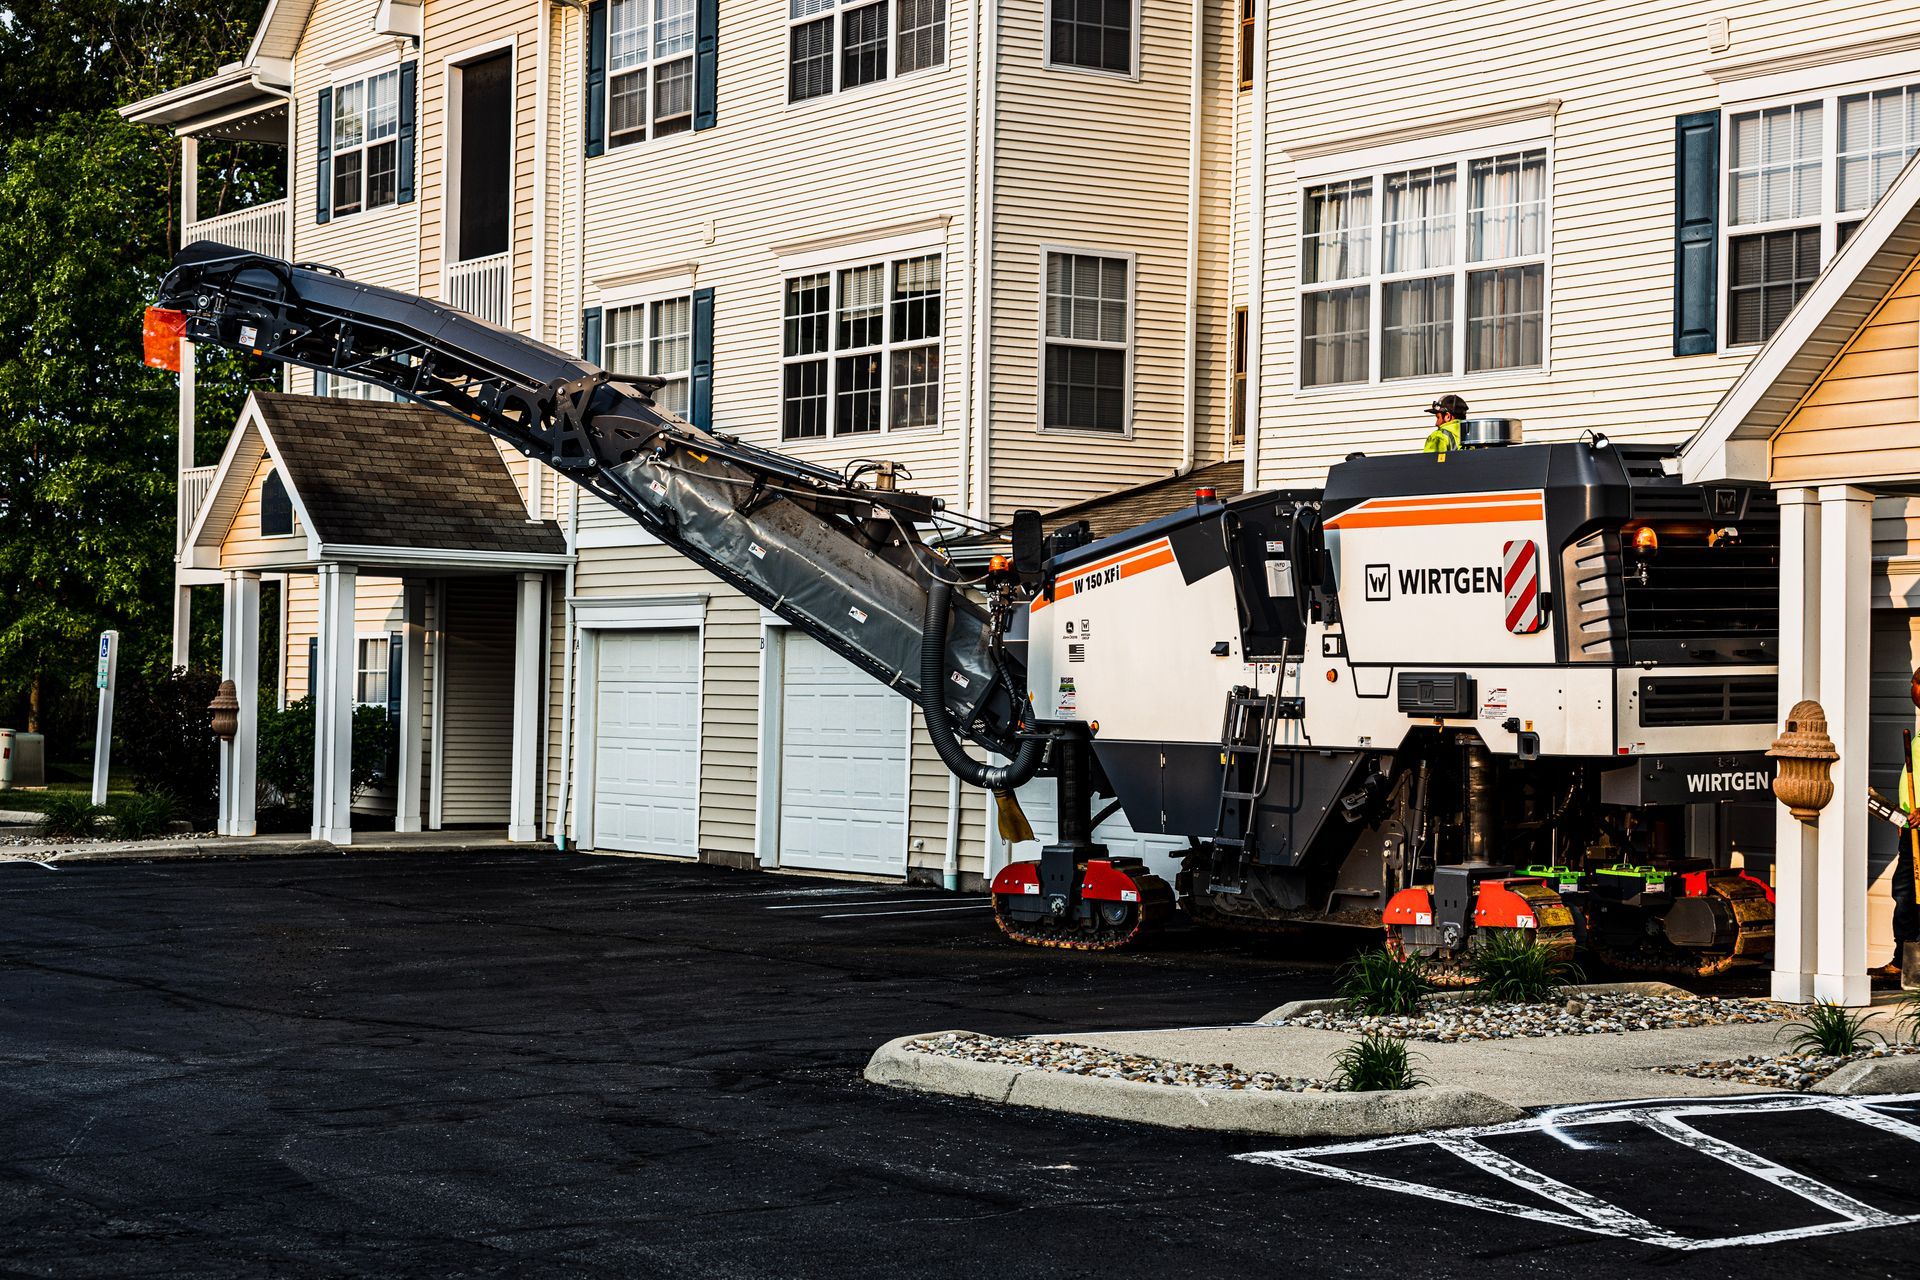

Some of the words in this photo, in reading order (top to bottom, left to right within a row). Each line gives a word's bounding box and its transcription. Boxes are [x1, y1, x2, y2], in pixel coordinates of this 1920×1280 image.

[1074, 578, 1084, 594] W
[1086, 572, 1102, 590] 150
[1104, 564, 1119, 585] XFi
[1398, 566, 1502, 594] WIRTGEN
[760, 637, 765, 650] B
[1687, 771, 1769, 793] WIRTGEN
